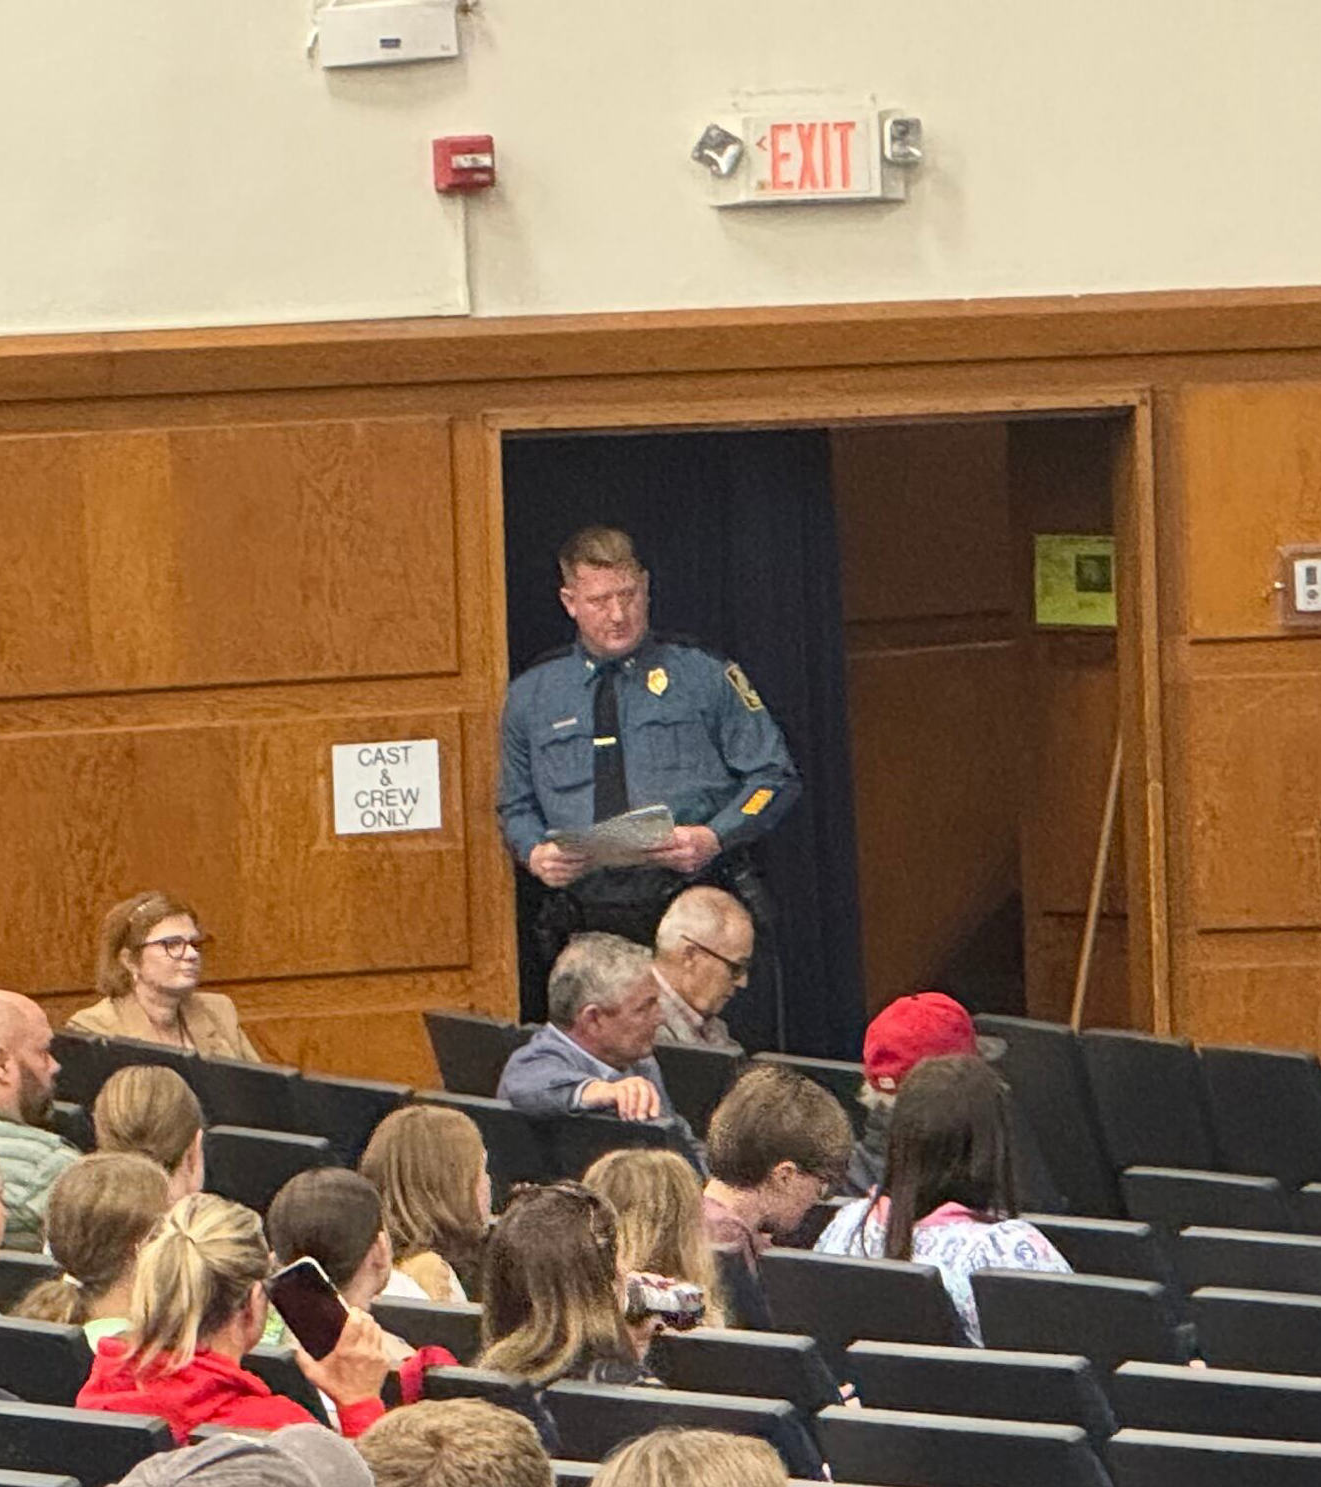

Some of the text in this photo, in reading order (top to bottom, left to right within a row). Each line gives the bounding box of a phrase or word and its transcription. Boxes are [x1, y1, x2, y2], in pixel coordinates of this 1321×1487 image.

[769, 121, 856, 190] EXIT
[358, 745, 412, 767] CAST
[379, 768, 393, 786] &
[354, 787, 420, 809] CREW
[360, 807, 414, 828] ONLY
